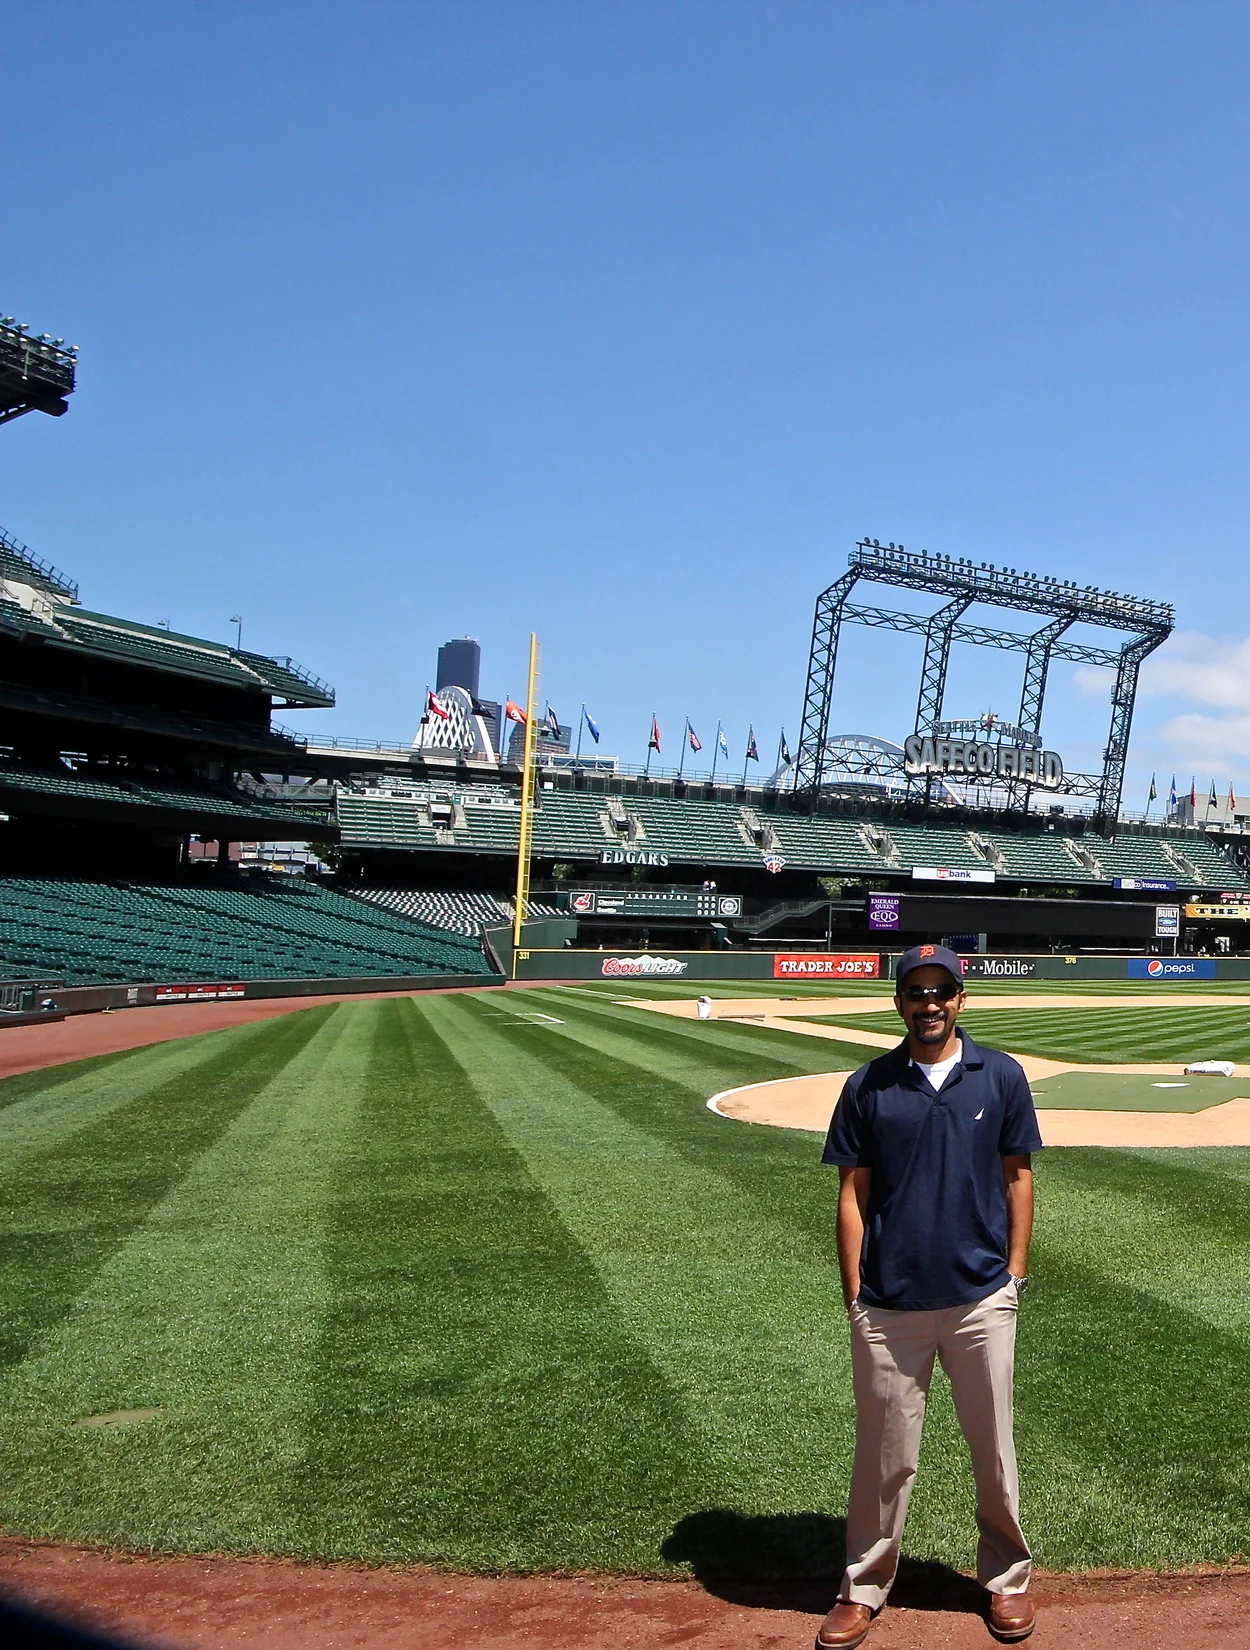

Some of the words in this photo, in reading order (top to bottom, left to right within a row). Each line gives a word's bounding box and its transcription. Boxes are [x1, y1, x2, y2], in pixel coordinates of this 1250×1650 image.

[904, 735, 994, 775] SAFECO
[998, 747, 1063, 788] FIELD
[601, 851, 669, 866] EDGARS
[768, 862, 781, 872] 42
[1159, 909, 1177, 918] BUILT
[518, 951, 530, 960] 331
[602, 958, 643, 975] Coors
[644, 963, 688, 974] LIGHT
[780, 961, 834, 973] TRADER
[836, 961, 875, 973] JOE'S
[1164, 963, 1195, 975] pepsi
